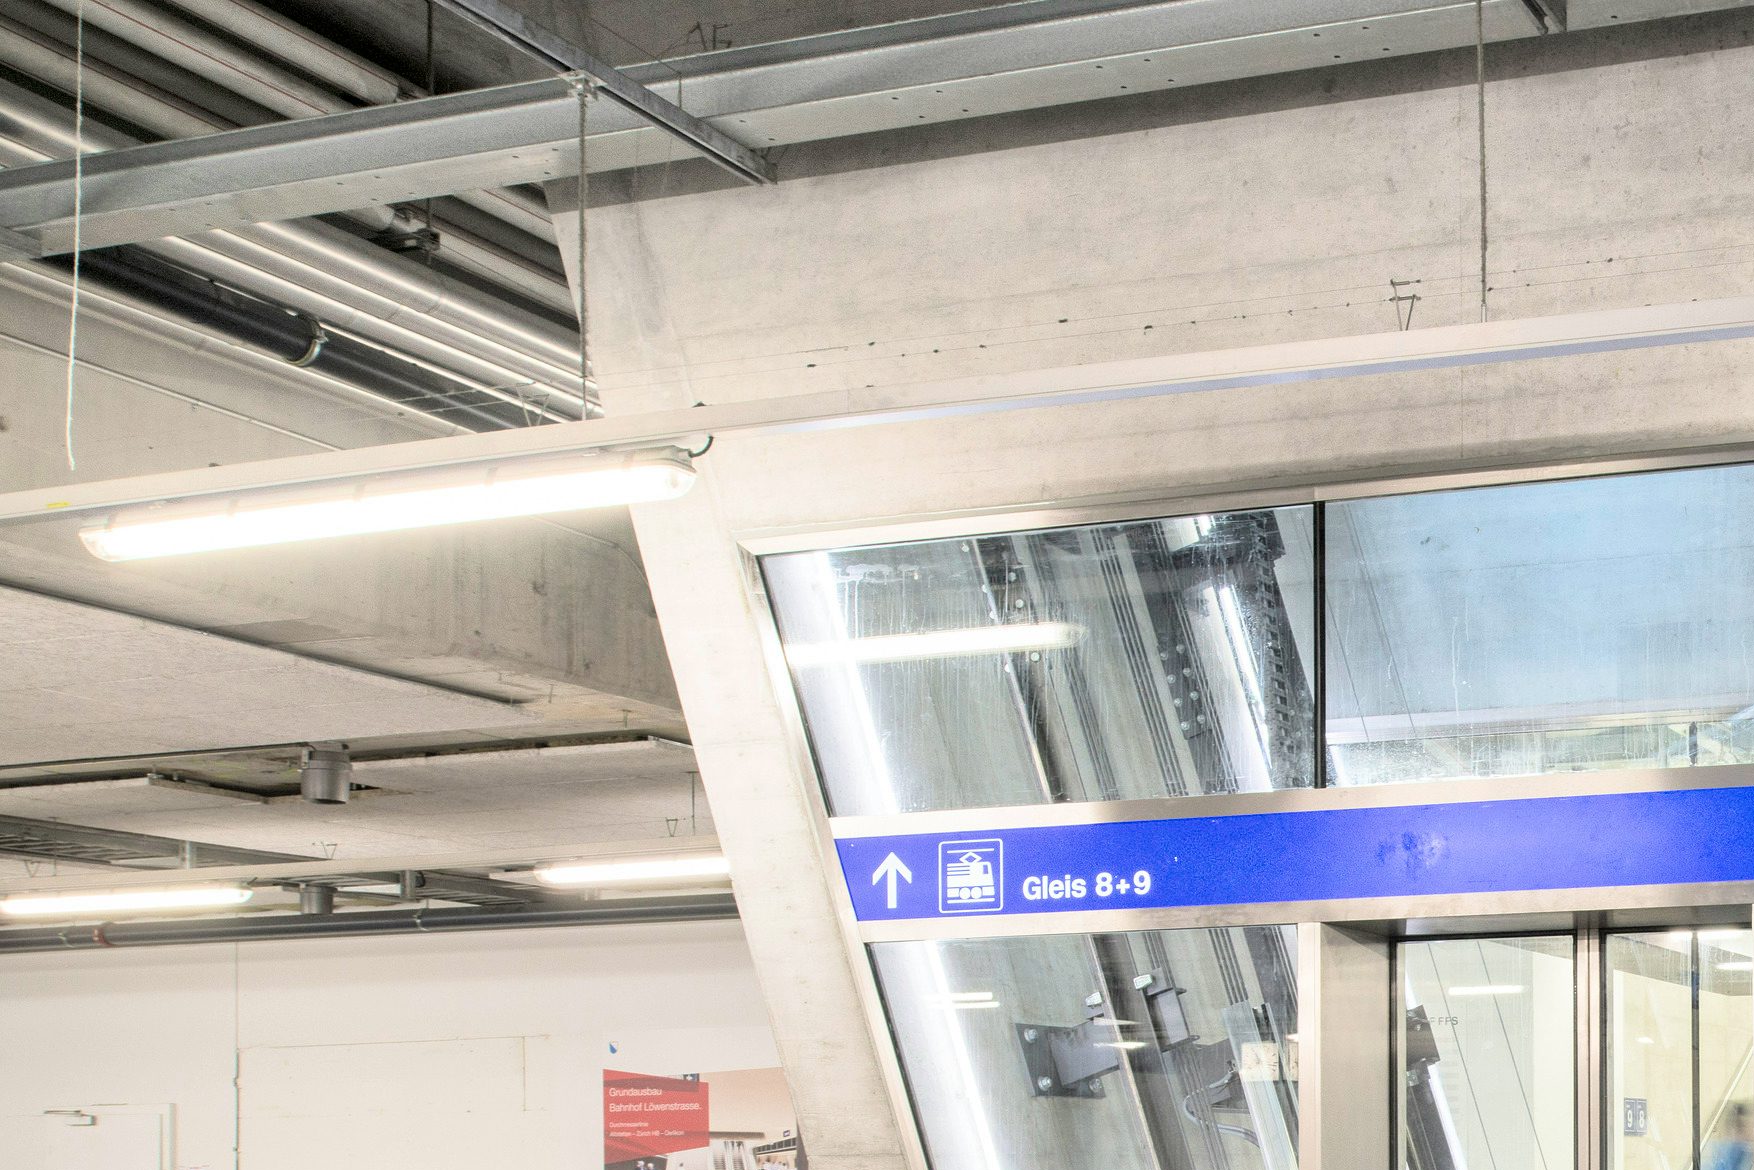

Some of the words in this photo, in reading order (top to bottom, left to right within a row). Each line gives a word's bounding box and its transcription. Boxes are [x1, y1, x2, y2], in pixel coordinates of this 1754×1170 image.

[1022, 874, 1087, 901] Gleis
[1095, 870, 1151, 897] 8+9
[609, 1087, 662, 1097] Grundausbau
[609, 1103, 642, 1112] Bahnhof
[1627, 1110, 1632, 1128] 9
[1639, 1110, 1644, 1128] 8
